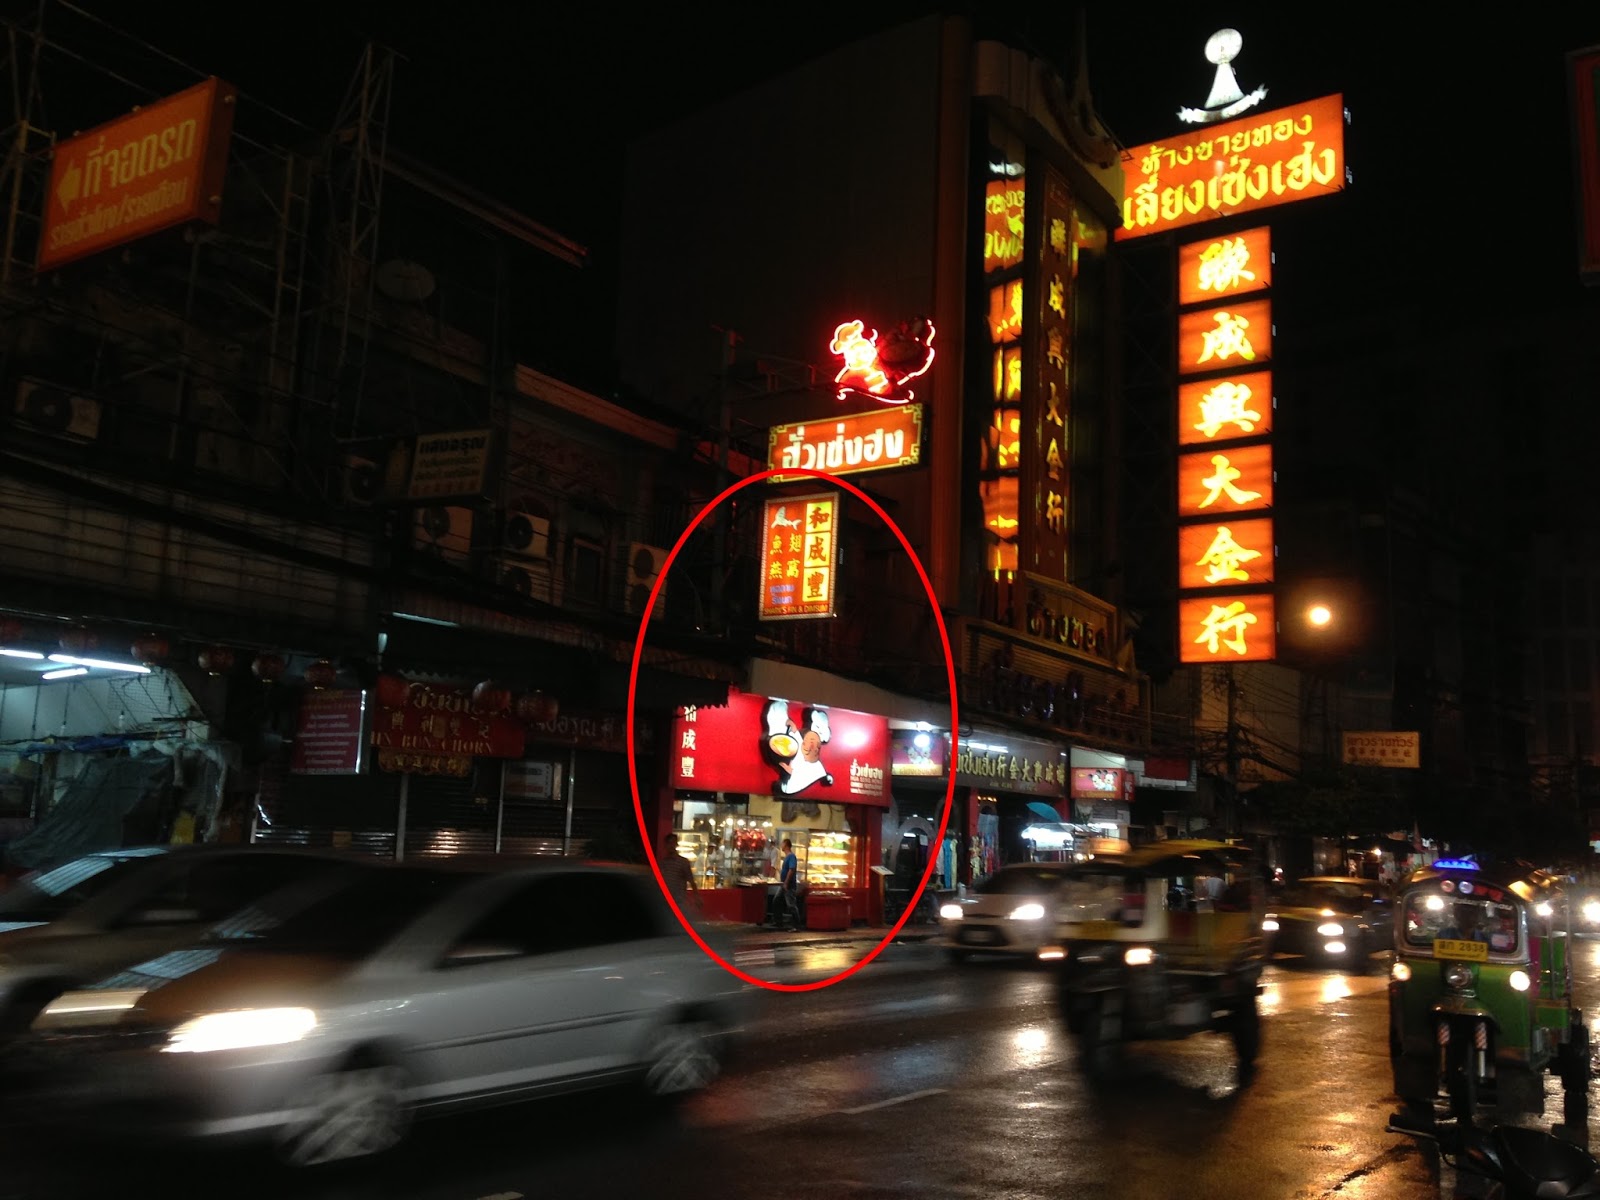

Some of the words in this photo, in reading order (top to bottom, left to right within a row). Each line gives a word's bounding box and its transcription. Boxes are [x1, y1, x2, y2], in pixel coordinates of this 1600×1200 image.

[1141, 114, 1313, 175] ห้างขายทอง
[781, 423, 905, 470] ฮั่วเซ่งฮง
